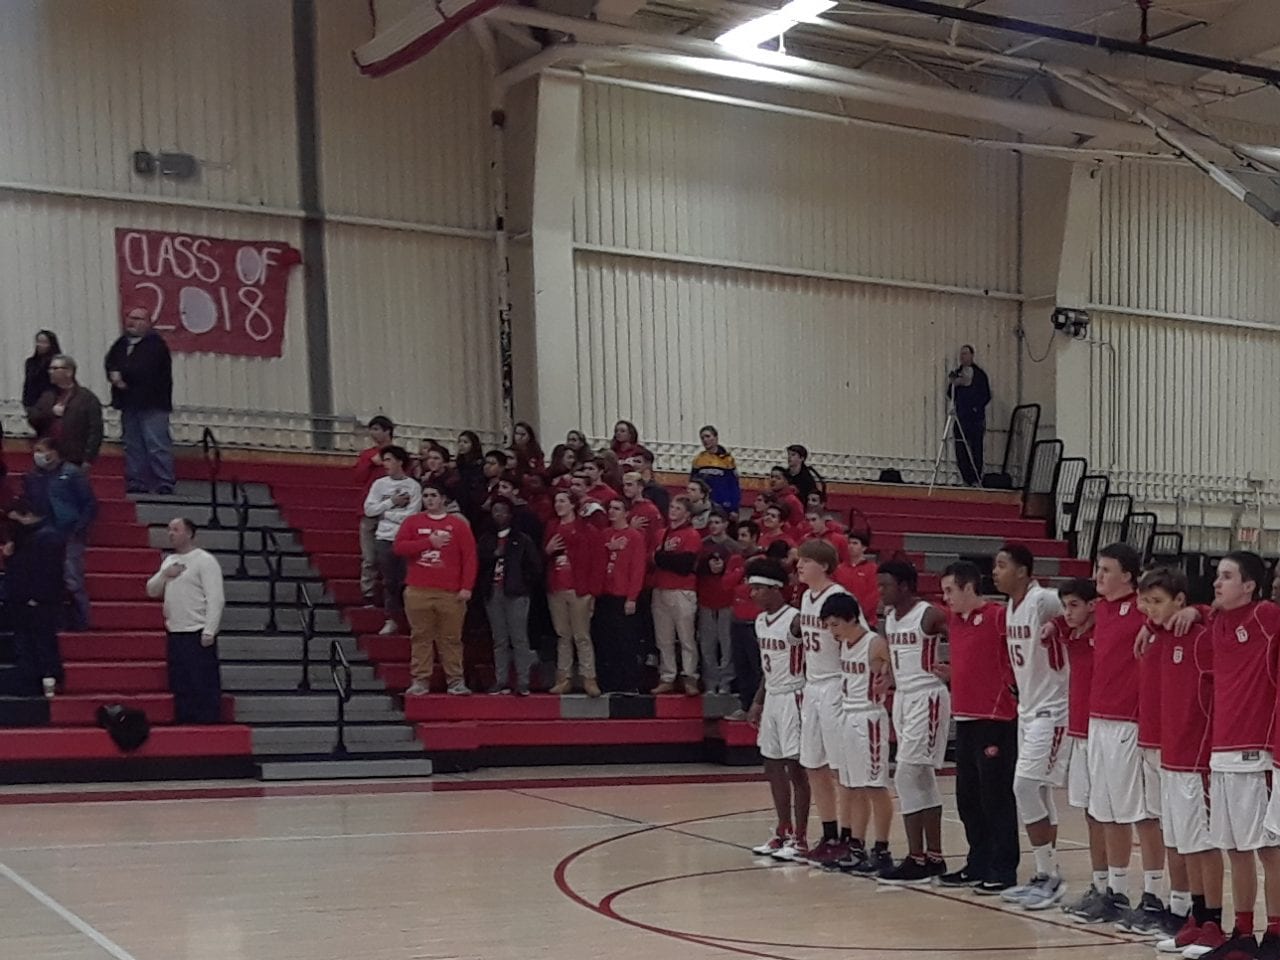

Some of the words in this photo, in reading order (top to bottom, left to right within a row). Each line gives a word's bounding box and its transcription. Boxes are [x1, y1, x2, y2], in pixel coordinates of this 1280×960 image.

[125, 232, 220, 282] CLASS
[236, 245, 282, 285] OF
[135, 282, 272, 340] 2018
[803, 631, 820, 652] 35
[763, 654, 771, 672] 3
[1010, 644, 1025, 666] 15
